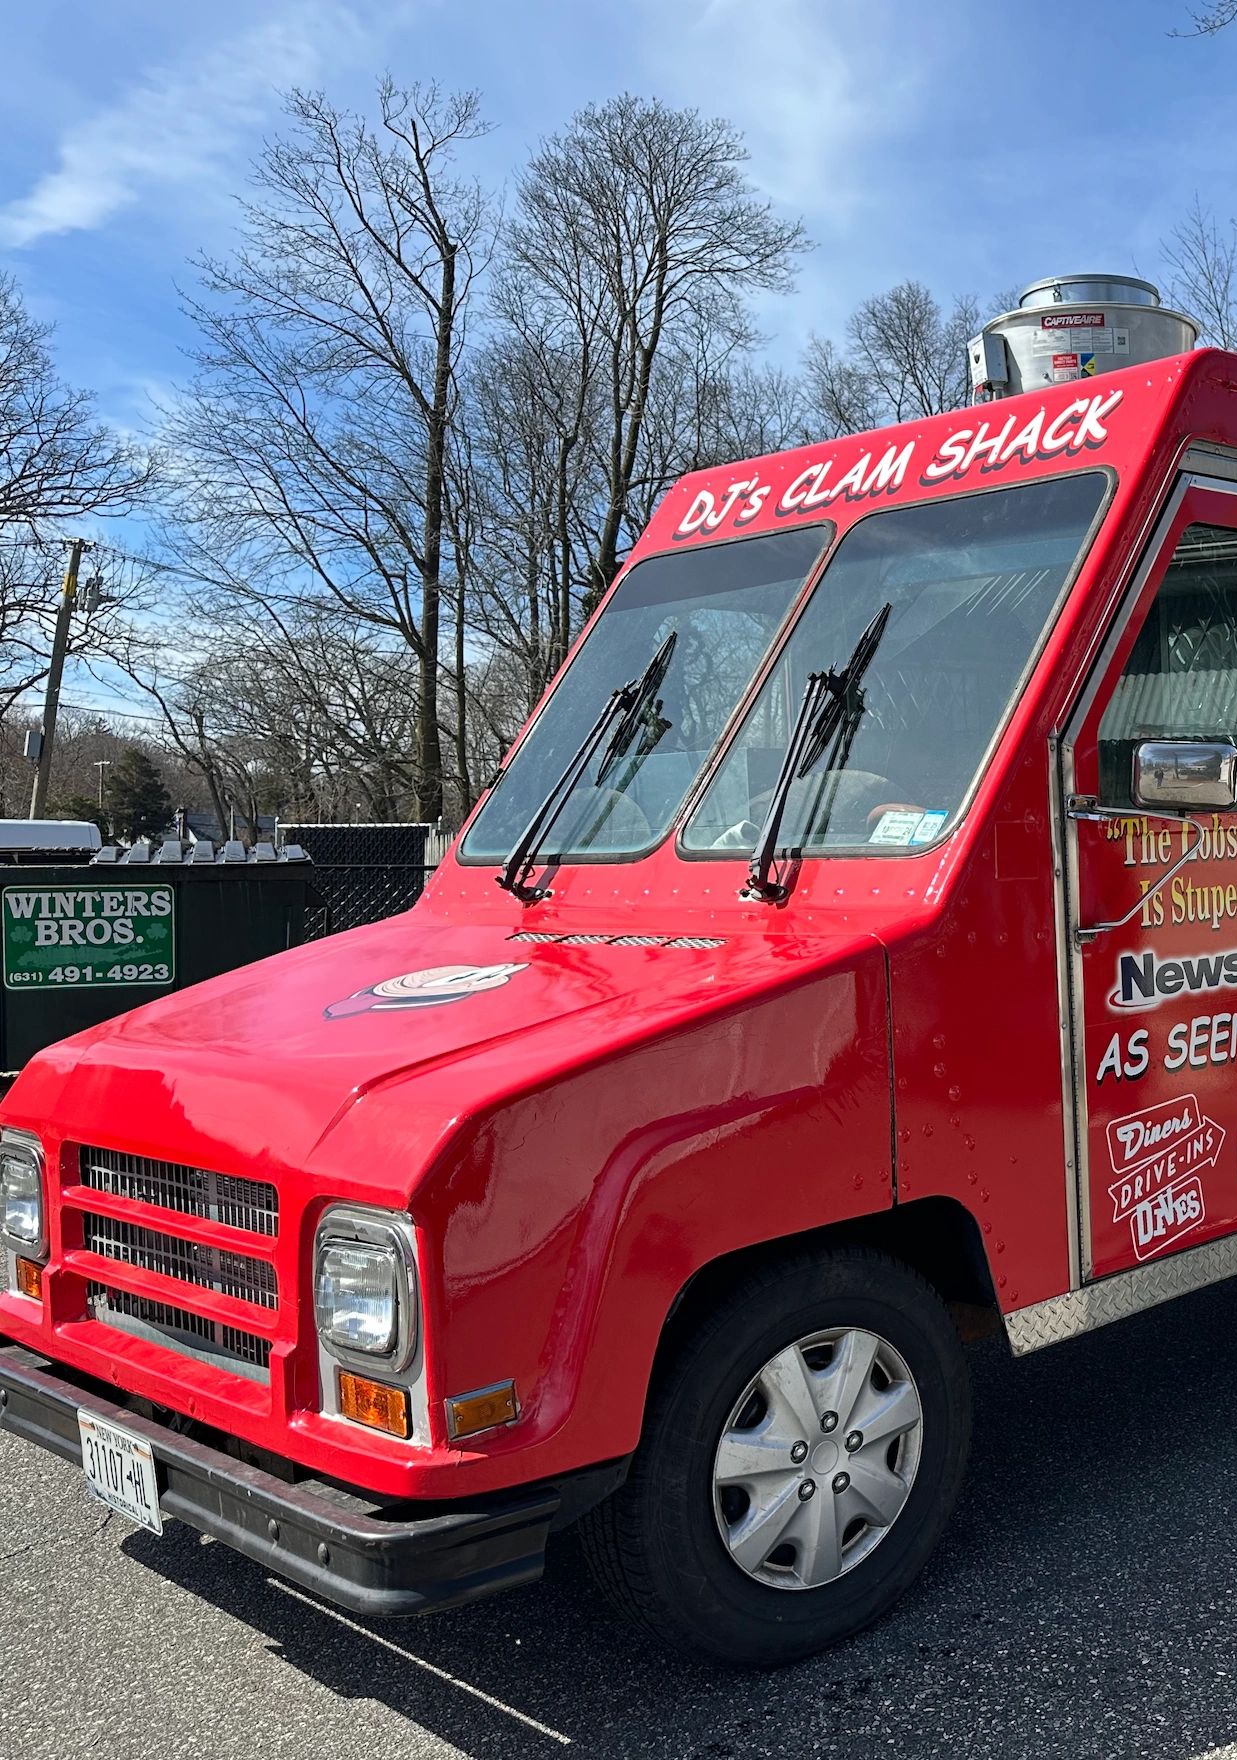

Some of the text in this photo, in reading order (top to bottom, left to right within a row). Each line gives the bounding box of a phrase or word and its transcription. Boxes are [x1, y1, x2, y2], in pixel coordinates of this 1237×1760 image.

[776, 441, 915, 516] CLAM
[921, 389, 1124, 487] SHACK
[5, 890, 172, 919] WINTERS
[1139, 879, 1165, 928] Is
[34, 918, 144, 947] BROS.
[9, 964, 169, 983] (631) 491-4923
[1096, 1028, 1150, 1083] AS
[1116, 1107, 1193, 1160] Diners
[1120, 1128, 1214, 1209] DRIVE-INS
[95, 1424, 134, 1455] NEW YORK
